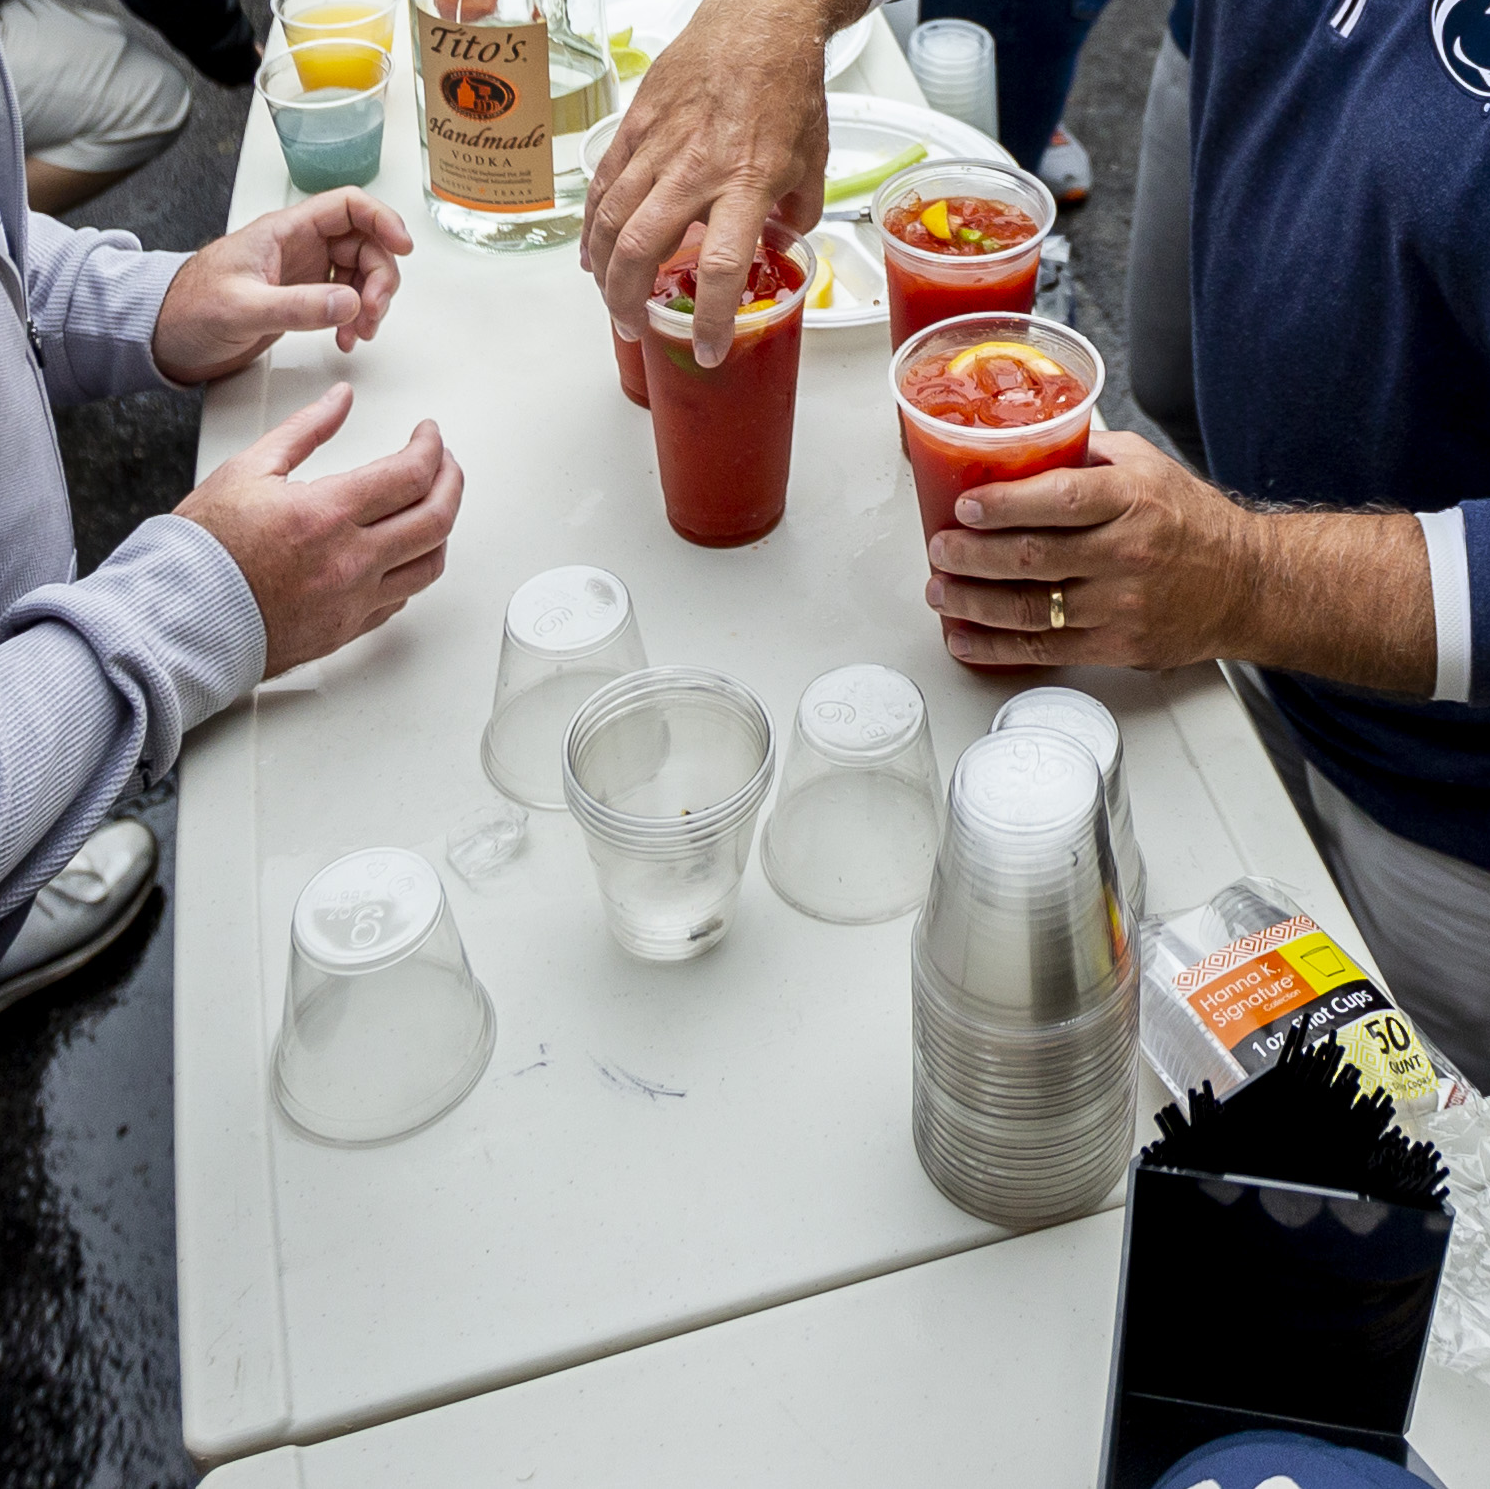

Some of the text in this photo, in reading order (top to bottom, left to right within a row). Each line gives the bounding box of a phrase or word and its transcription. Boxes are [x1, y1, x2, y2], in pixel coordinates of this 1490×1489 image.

[430, 25, 527, 63] Tito's
[429, 116, 545, 150] Handmade
[451, 149, 513, 168] VODKA
[1199, 962, 1281, 1012] Hanna K.
[1262, 988, 1302, 1012] Collection
[1252, 1041, 1267, 1058] 1
[1331, 990, 1373, 1013] Cups
[1364, 1016, 1411, 1055] 50
